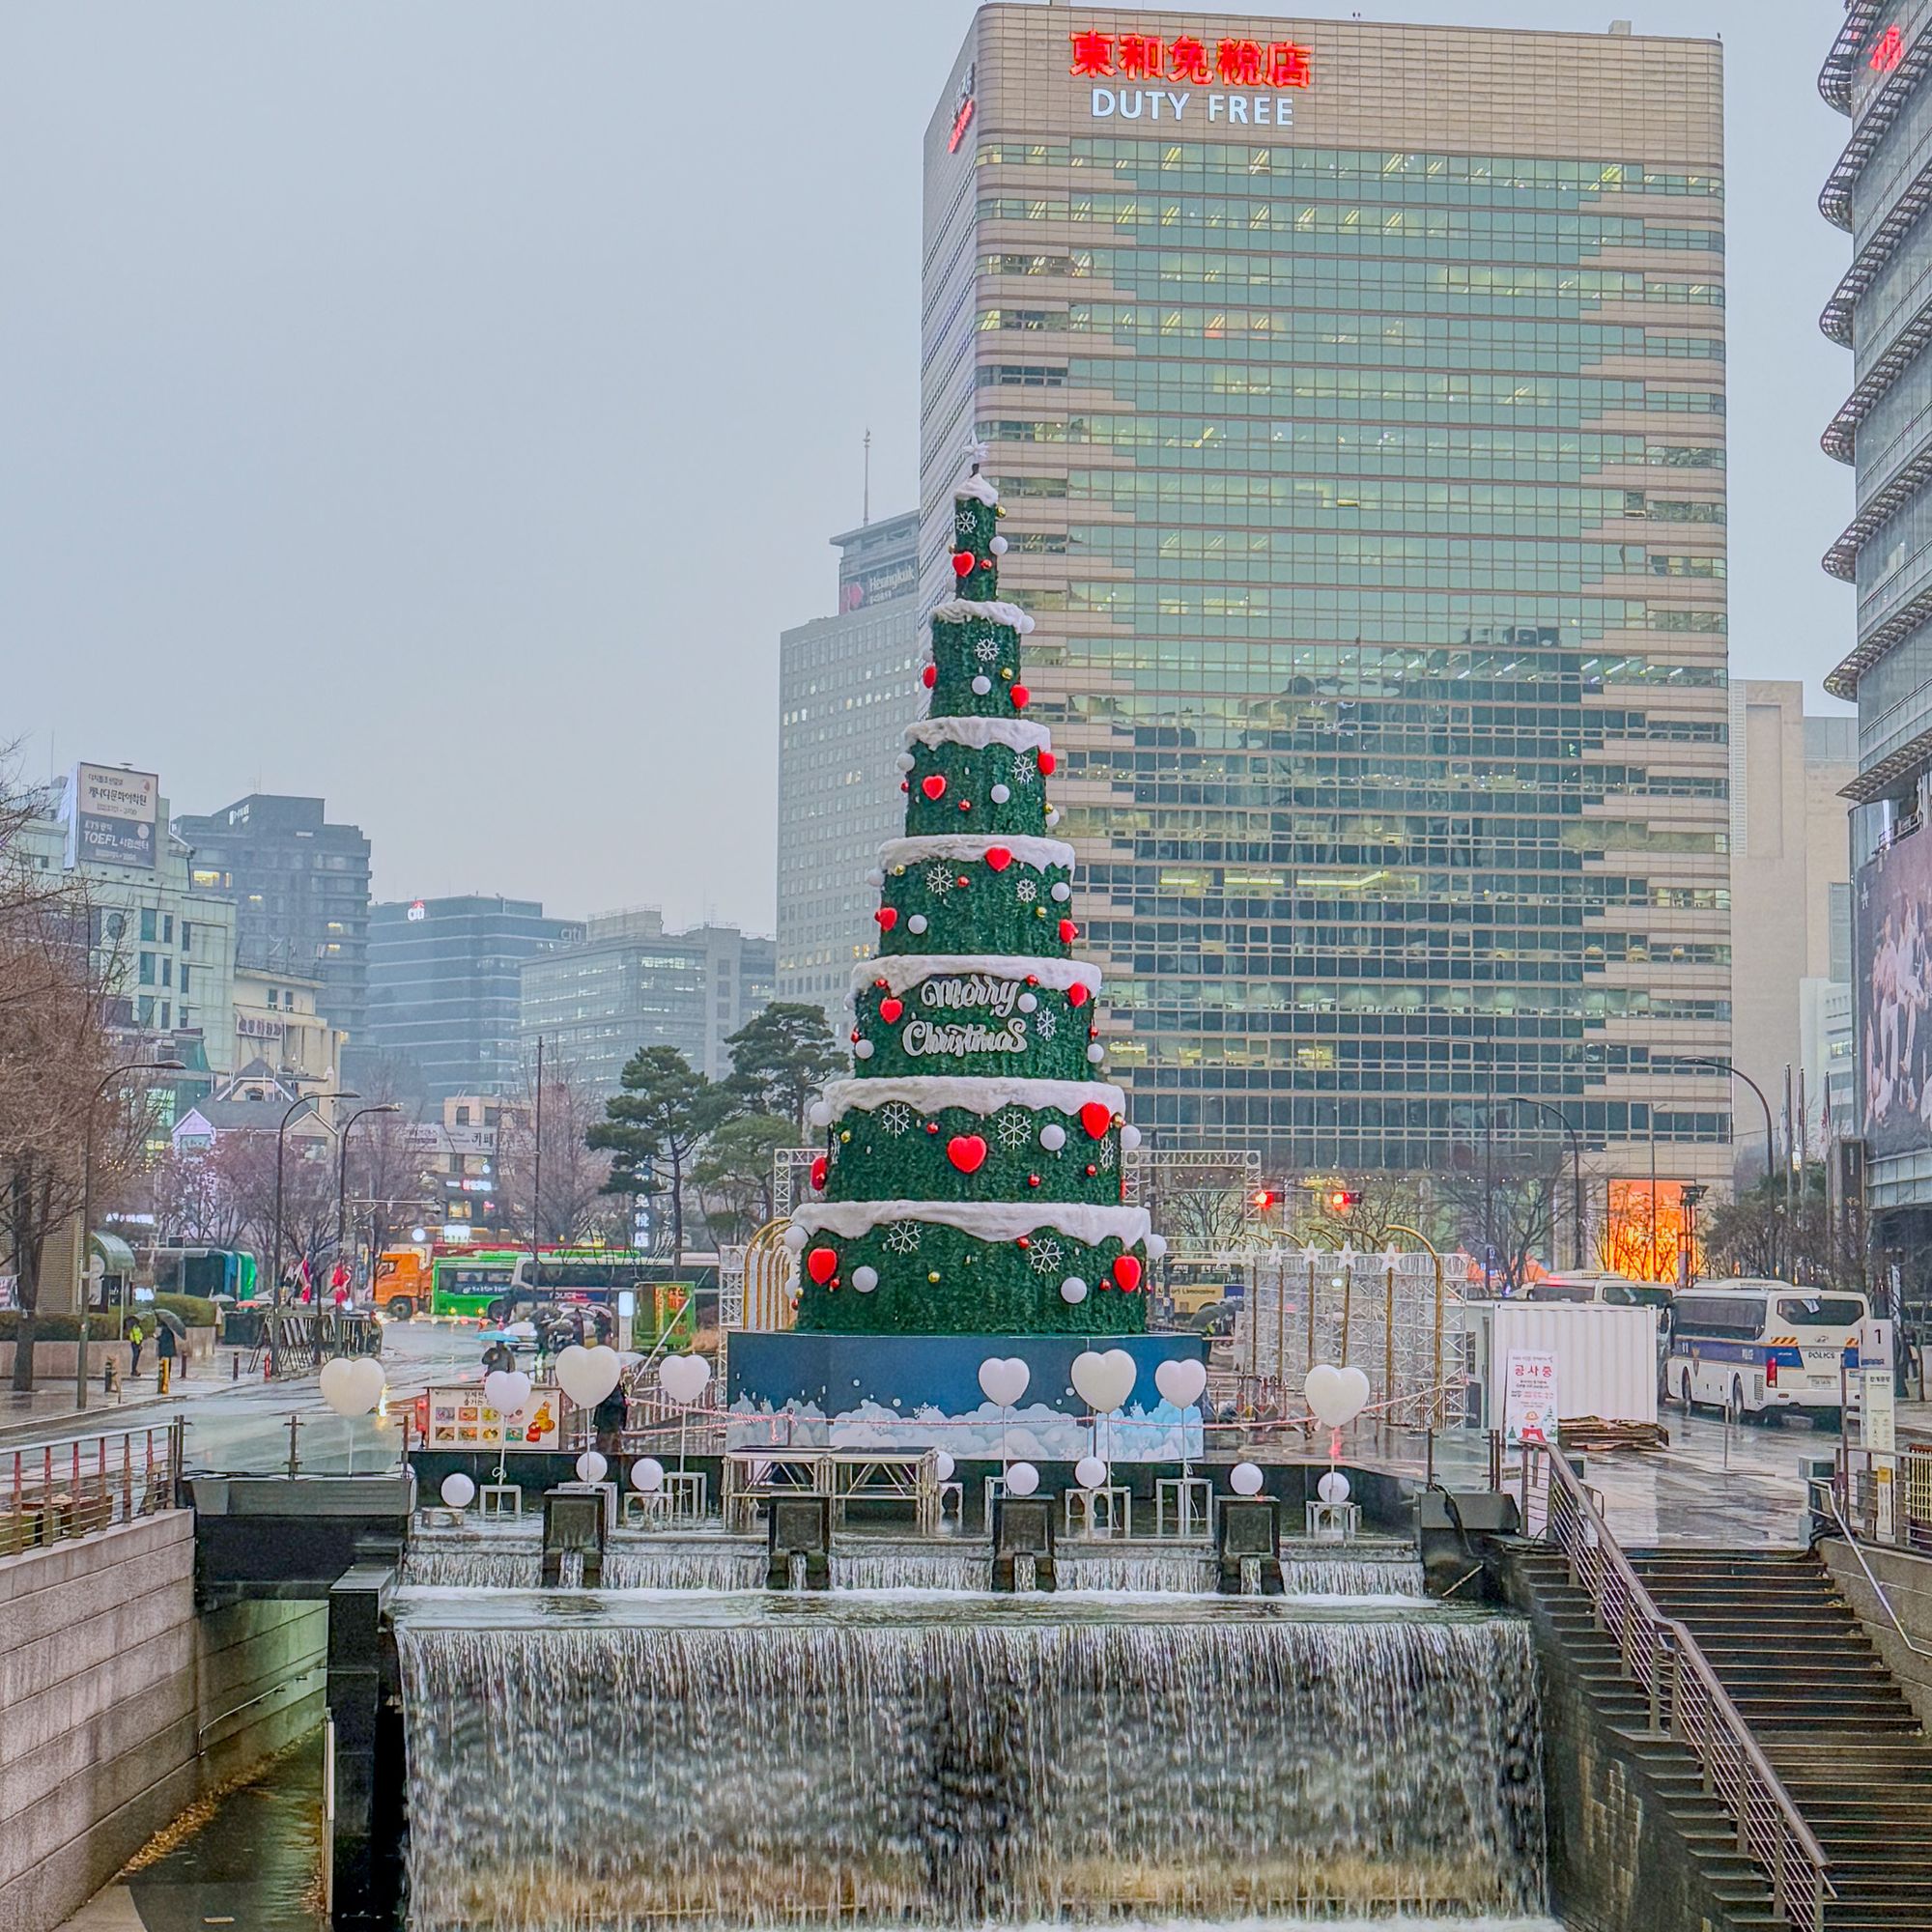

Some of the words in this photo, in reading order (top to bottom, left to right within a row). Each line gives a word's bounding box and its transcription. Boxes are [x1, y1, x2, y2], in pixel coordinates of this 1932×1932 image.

[1092, 88, 1190, 121] DUTY
[1208, 94, 1294, 127] FREE
[84, 831, 118, 847] TOEFL
[921, 974, 1020, 1017] Merry
[902, 1017, 1028, 1058] Christmas
[1873, 1328, 1882, 1345] 1
